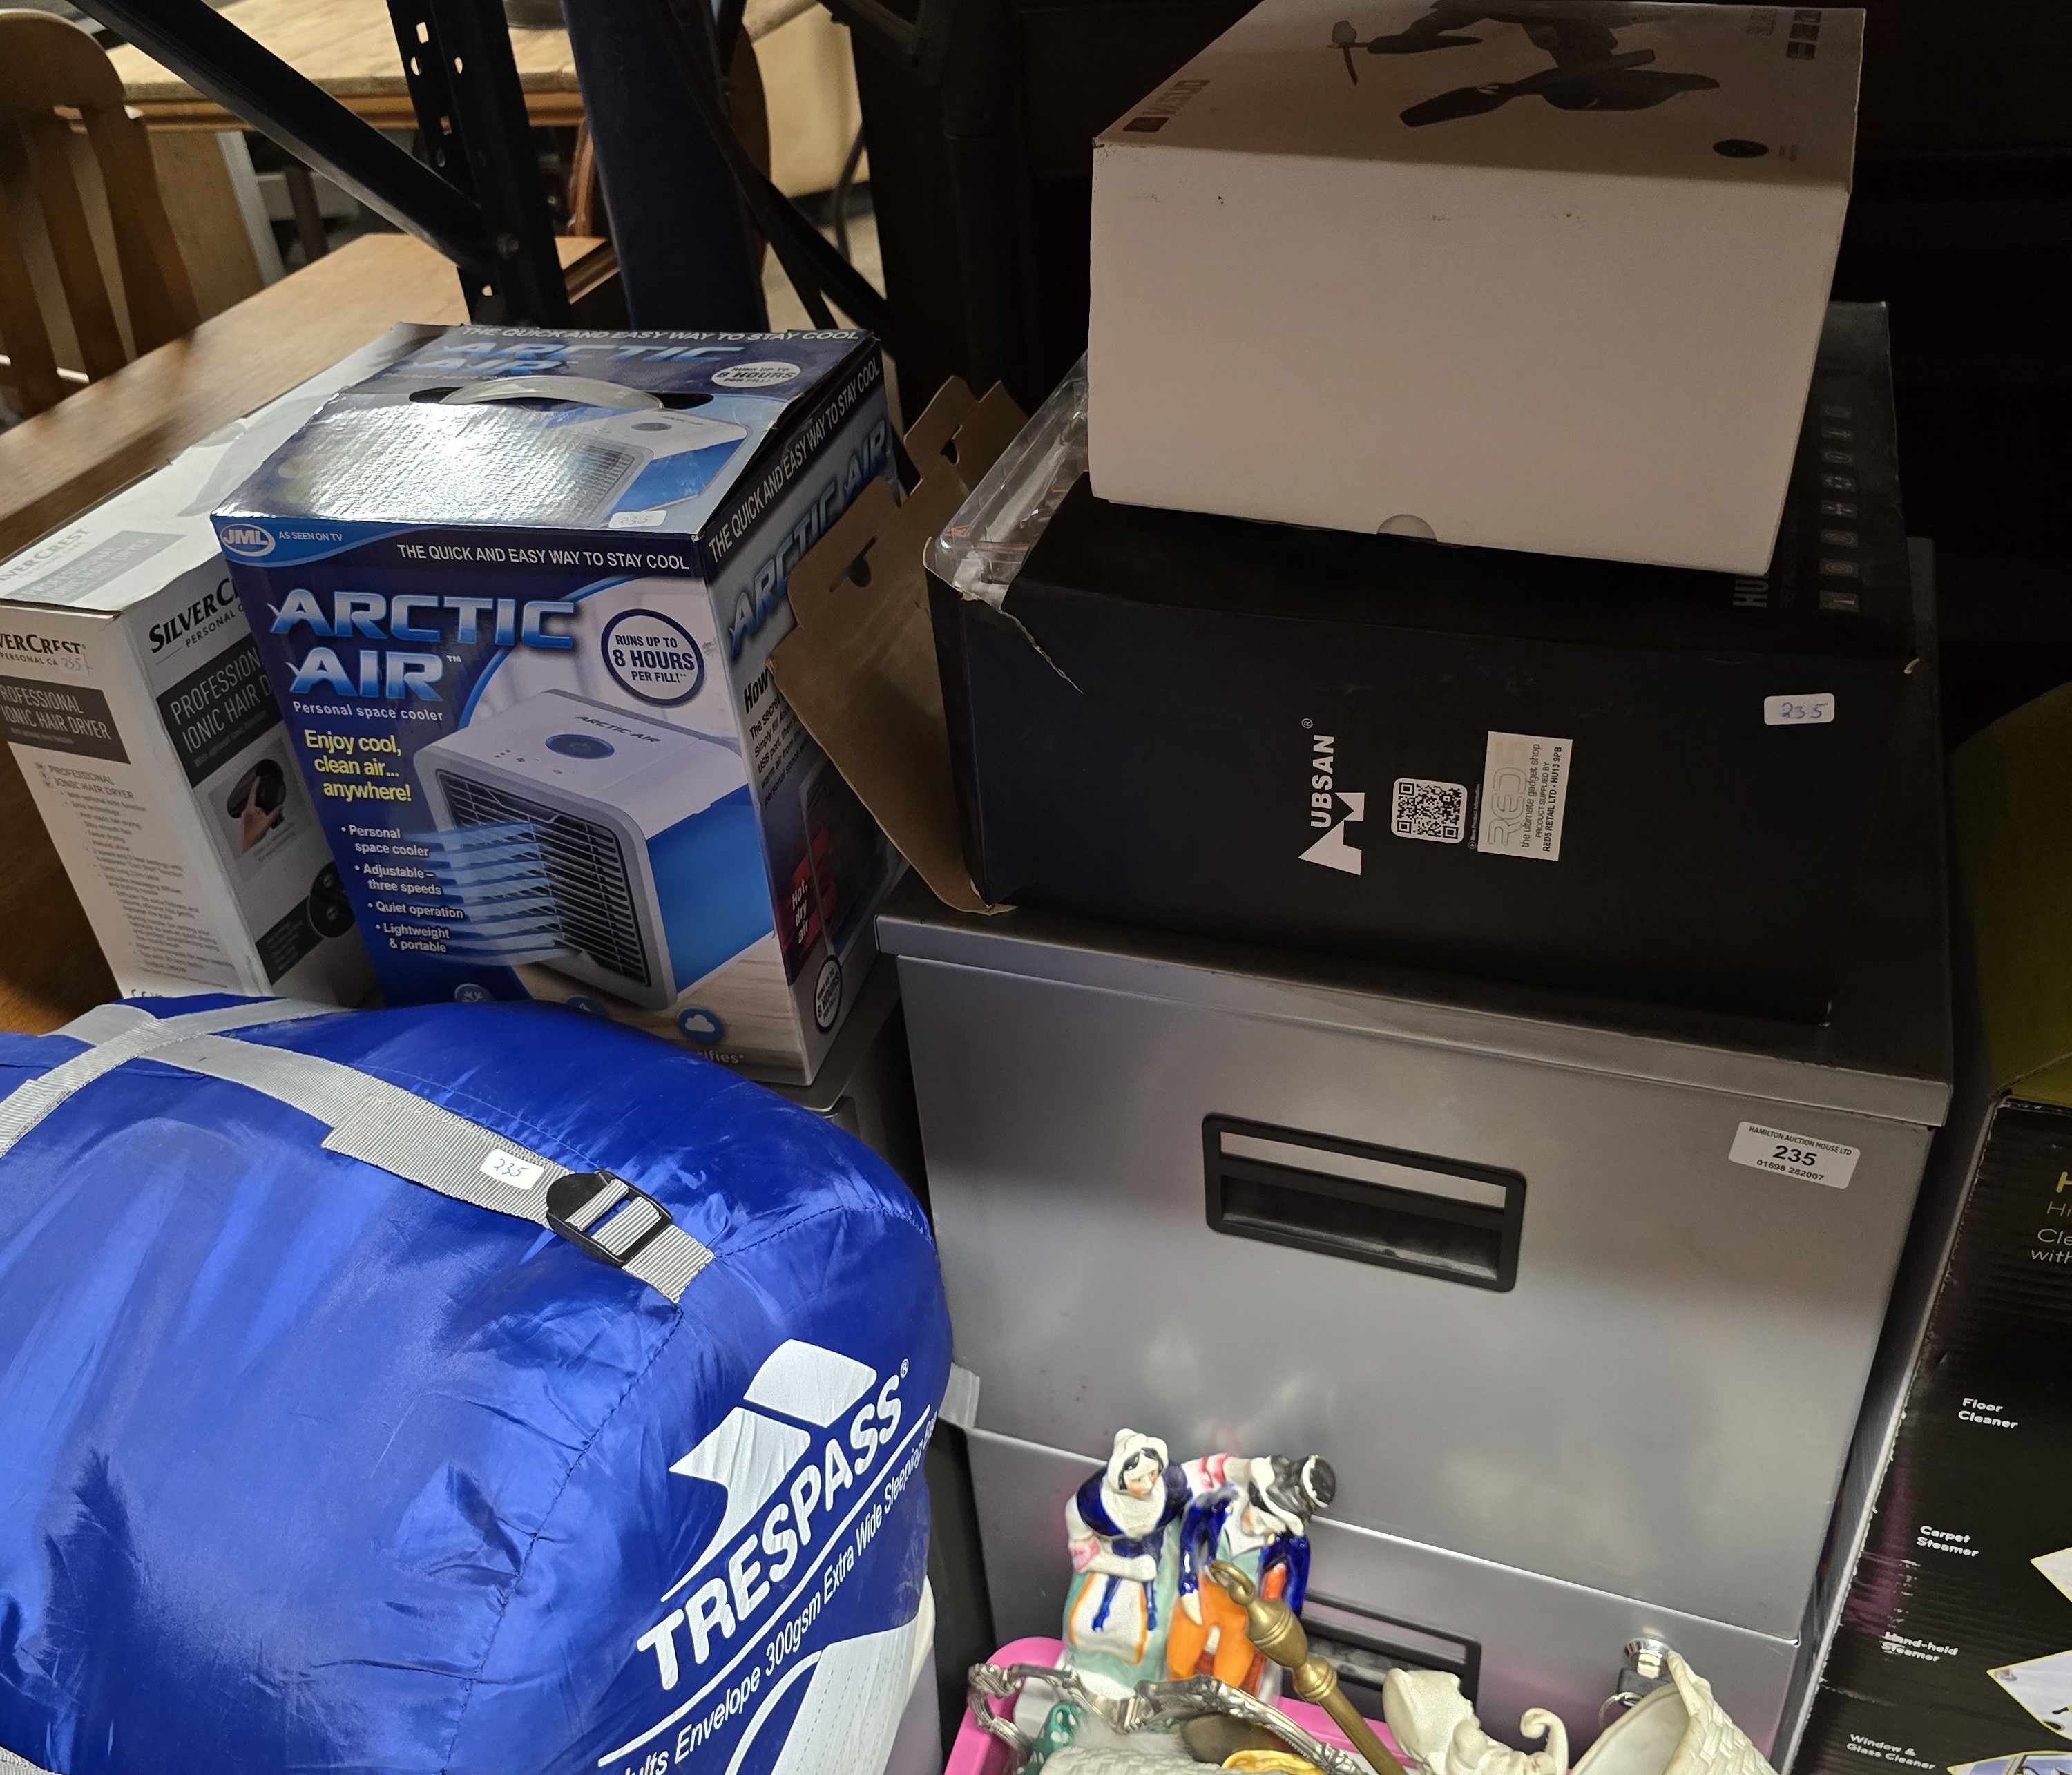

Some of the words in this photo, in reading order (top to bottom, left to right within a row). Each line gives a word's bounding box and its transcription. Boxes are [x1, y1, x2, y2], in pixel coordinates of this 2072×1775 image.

[461, 327, 500, 337] THE
[501, 328, 561, 338] QUICK
[559, 329, 614, 338] AND
[611, 330, 669, 339] EASY
[669, 331, 717, 340] WAY
[717, 332, 748, 340] TO
[746, 332, 800, 340] STAY
[801, 331, 861, 340] COOL
[425, 342, 747, 362] ARCTIC
[708, 522, 733, 563] THE
[731, 486, 765, 538] QUICK
[763, 466, 784, 510] AND
[783, 434, 807, 481] EASY
[805, 418, 827, 454] WAY
[825, 401, 839, 432] TO
[837, 379, 858, 417] STAY
[857, 356, 881, 395] COOL
[222, 528, 270, 546] JML
[279, 530, 291, 540] AS
[291, 530, 315, 541] SEEN
[314, 532, 329, 541] ON
[329, 532, 343, 542] TV
[0, 528, 90, 584] LVERCREST
[396, 544, 425, 560] THE
[428, 545, 474, 561] QUICK
[476, 547, 506, 563] AND
[508, 548, 546, 564] EASY
[548, 549, 581, 566] WAY
[582, 550, 605, 567] TO
[606, 552, 643, 568] STAY
[646, 553, 691, 571] COOL
[148, 577, 240, 654] SILVERC
[266, 588, 576, 650] ARCTIC
[185, 608, 236, 649] PERSONAL
[615, 634, 644, 646] RUNS
[646, 635, 661, 648] UP
[662, 637, 678, 649] TO
[1, 653, 44, 665] PERSONAL
[612, 649, 626, 668] 8
[632, 649, 696, 671] HOURS
[169, 647, 264, 726] PROFESSION
[631, 671, 653, 682] PER
[1, 704, 37, 727] IONIC
[35, 711, 69, 733] HAIR
[67, 716, 111, 740] DRYER
[182, 707, 226, 754] IONIC
[224, 683, 261, 723] HAIR
[292, 700, 353, 716] Personal
[356, 706, 397, 720] space
[400, 709, 443, 722] cooler
[749, 720, 763, 741] The
[762, 692, 781, 725] secret
[1780, 702, 1828, 720] 235
[574, 714, 634, 736] ARCTIC
[631, 733, 661, 744] AIR
[304, 729, 354, 755] Enjoy
[358, 734, 402, 757] cool,
[754, 730, 773, 758] Simply
[1553, 746, 1562, 762] 9PB
[314, 754, 361, 776] clean
[757, 750, 770, 774] USB
[1530, 743, 1542, 766] shop
[47, 764, 115, 786] PROFESSIONAL
[1542, 761, 1550, 771] BY
[1550, 763, 1560, 783] HU13
[54, 776, 81, 790] IONIC
[81, 783, 104, 795] HAIR
[104, 786, 135, 800] DRYER
[322, 781, 413, 803] anywhere!
[764, 767, 787, 809] personal
[1526, 767, 1539, 797] gadget
[1539, 772, 1548, 805] SUPPLIED
[1548, 789, 1557, 803] LTD
[1522, 798, 1535, 833] ultimate
[1535, 806, 1545, 838] PRODUCT
[1544, 805, 1555, 832] RETAIL
[348, 824, 401, 840] Personal
[1520, 834, 1531, 848] the
[1542, 832, 1552, 852] RED5
[354, 842, 390, 856] space
[392, 843, 430, 858] cooler
[363, 863, 425, 879] Adjustable
[367, 878, 399, 892] three
[400, 881, 443, 896] speeds
[791, 878, 809, 911] Hot,
[375, 901, 407, 916] Quiet
[409, 903, 464, 919] operation
[794, 897, 809, 929] dry
[383, 922, 450, 940] Lightweight
[797, 917, 810, 945] air
[389, 938, 399, 950] &
[401, 939, 448, 954] portable
[1748, 1125, 1784, 1140] HAMILTON
[1784, 1134, 1815, 1148] AUCTION
[1815, 1141, 1839, 1153] HOUSE
[1839, 1148, 1853, 1156] LTD
[1772, 1144, 1818, 1167] 235
[492, 1157, 530, 1179] 235
[1756, 1159, 1786, 1172] 01698
[1787, 1166, 1825, 1182] 282007
[1961, 1397, 2004, 1414] Floor
[1958, 1410, 2019, 1430] Cleaner
[1919, 1524, 1972, 1544] Carpet
[1916, 1536, 1979, 1558] Steamer
[674, 1664, 760, 1765] Envelope
[765, 1594, 822, 1678] 300gsm
[823, 1544, 855, 1604] Extra
[854, 1505, 883, 1558] Wide
[883, 1438, 924, 1515] Sleeping
[1881, 1641, 1941, 1663] Steamer
[1884, 1631, 1959, 1657] Hand-held
[1850, 1732, 1902, 1753] Window
[1903, 1747, 1917, 1757] &
[1845, 1743, 1882, 1760] Glass
[1884, 1752, 1936, 1772] Cleaner
